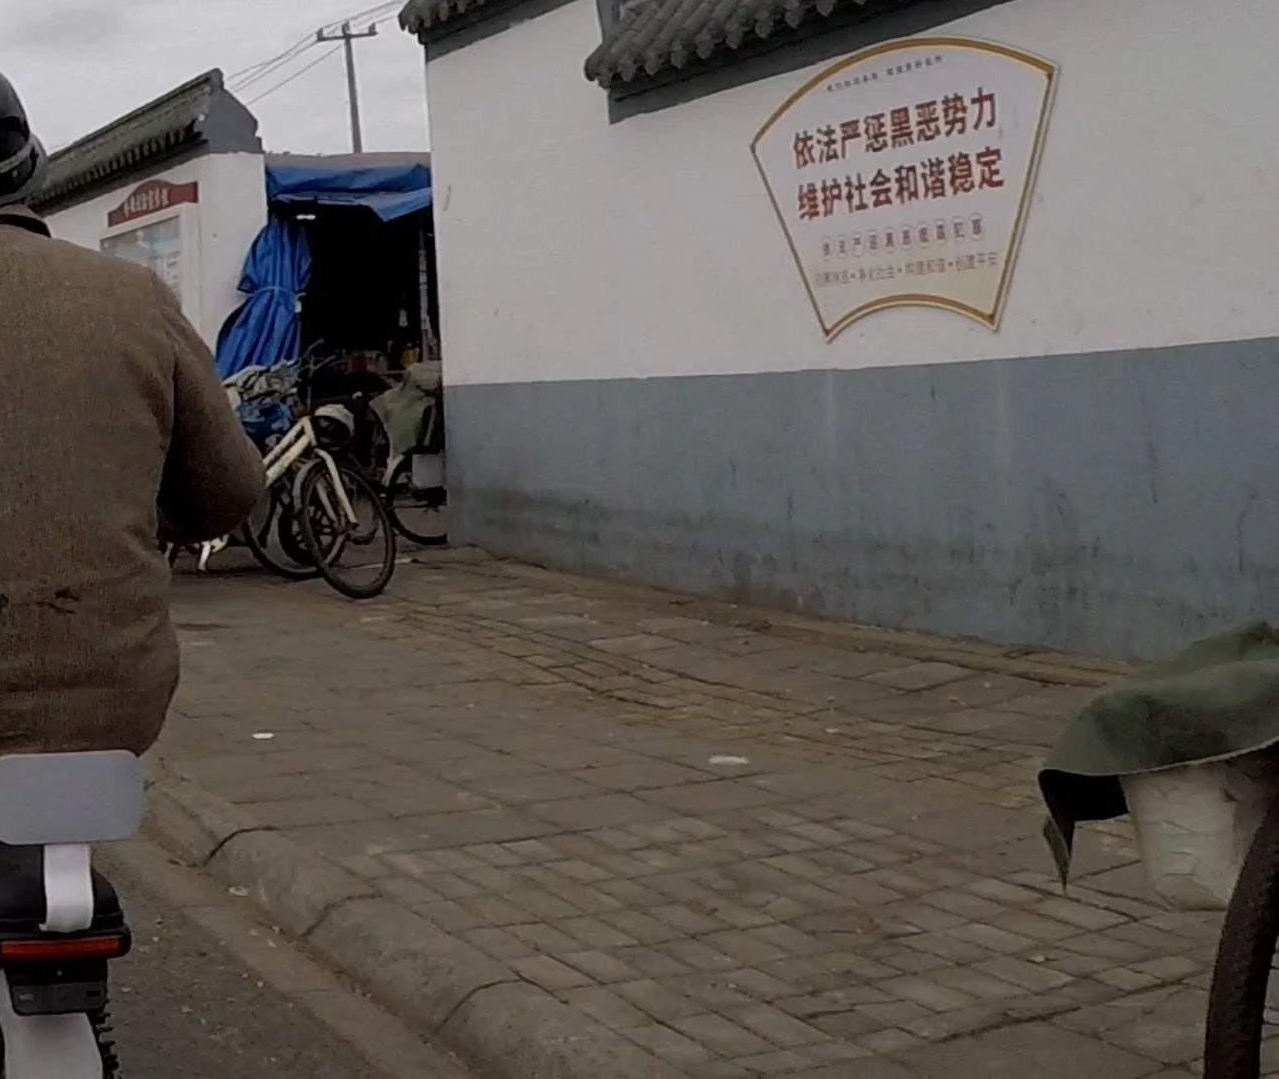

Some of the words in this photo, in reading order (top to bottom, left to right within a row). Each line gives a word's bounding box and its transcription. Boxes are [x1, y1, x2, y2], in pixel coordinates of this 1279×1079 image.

[794, 87, 997, 170] 依法严惩黑恶势力
[798, 146, 1005, 220] 维护社会和谐稳定
